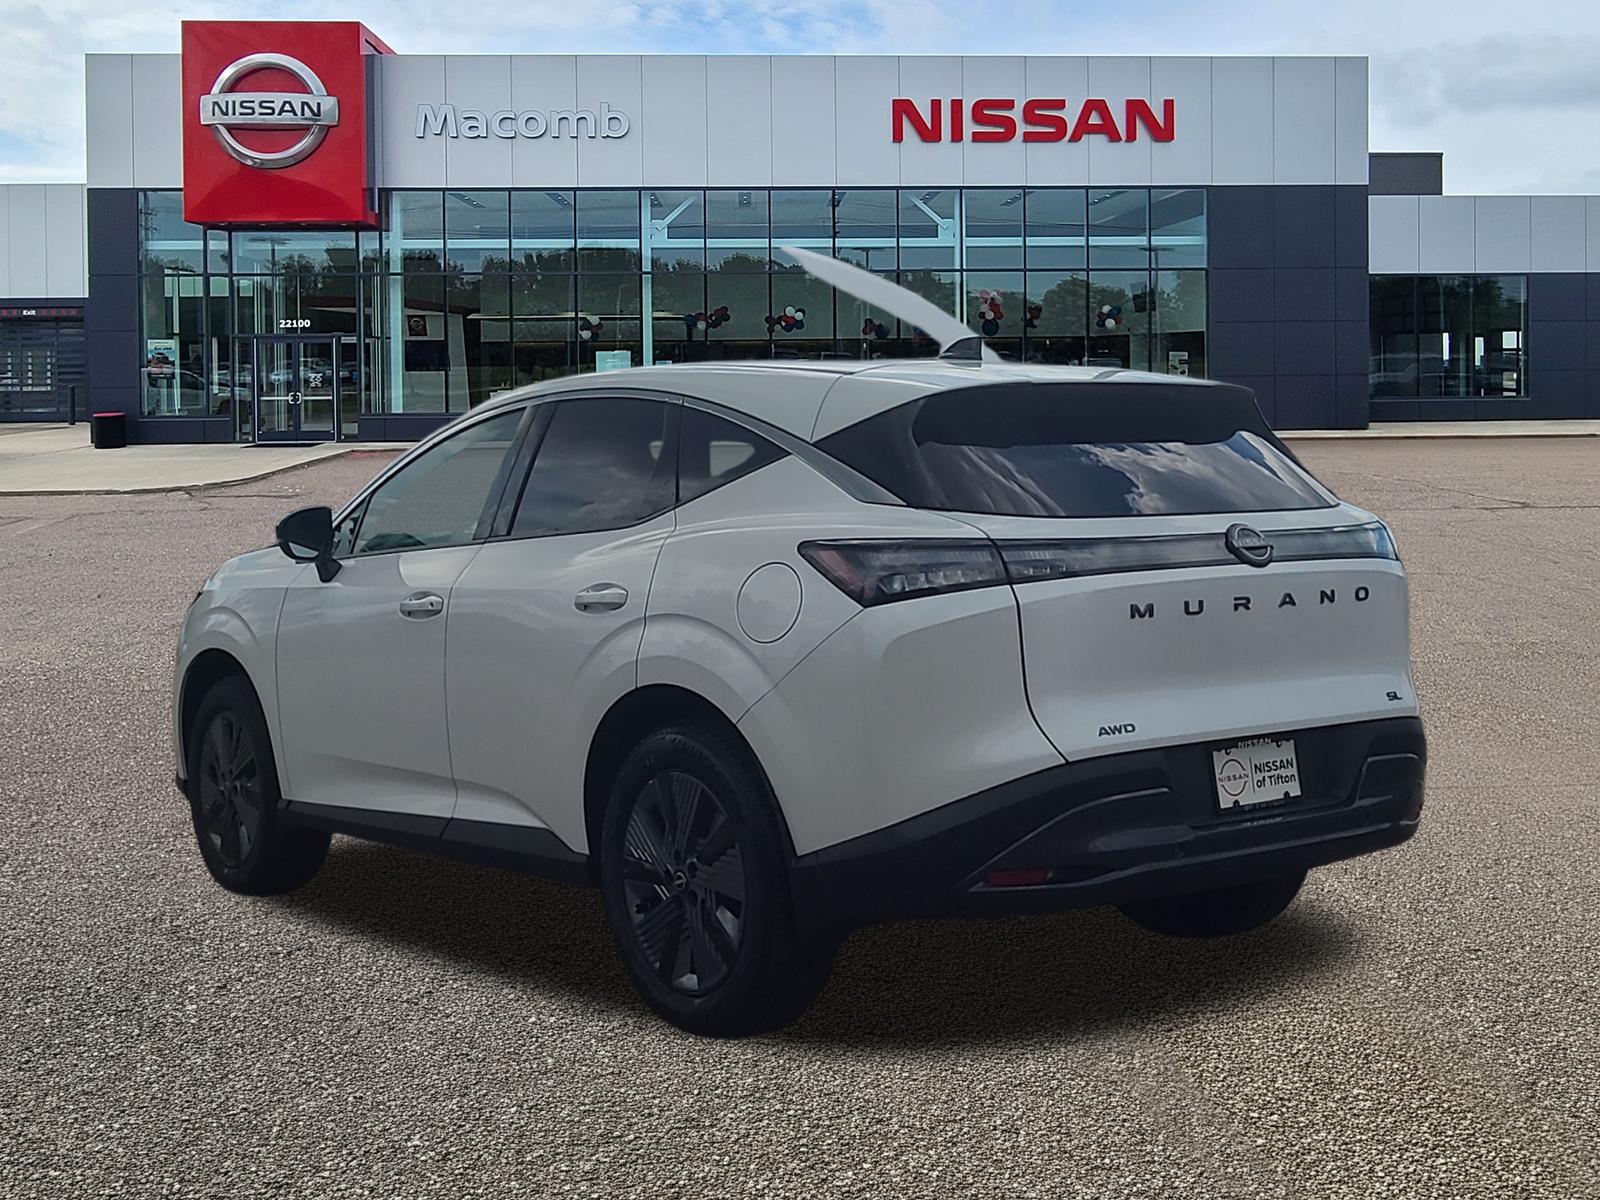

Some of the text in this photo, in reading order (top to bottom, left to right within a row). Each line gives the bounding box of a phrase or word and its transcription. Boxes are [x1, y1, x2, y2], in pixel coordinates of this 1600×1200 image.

[212, 100, 321, 117] NISSAN
[415, 102, 630, 138] Macomb
[892, 99, 1175, 142] NISSAN
[280, 319, 311, 328] 22100
[1129, 586, 1370, 619] MURANO
[1386, 691, 1403, 701] SL
[1098, 723, 1136, 737] AWD
[1254, 758, 1294, 774] NISSAN
[1218, 773, 1249, 782] NISSAN
[1256, 774, 1296, 788] of Tifton
